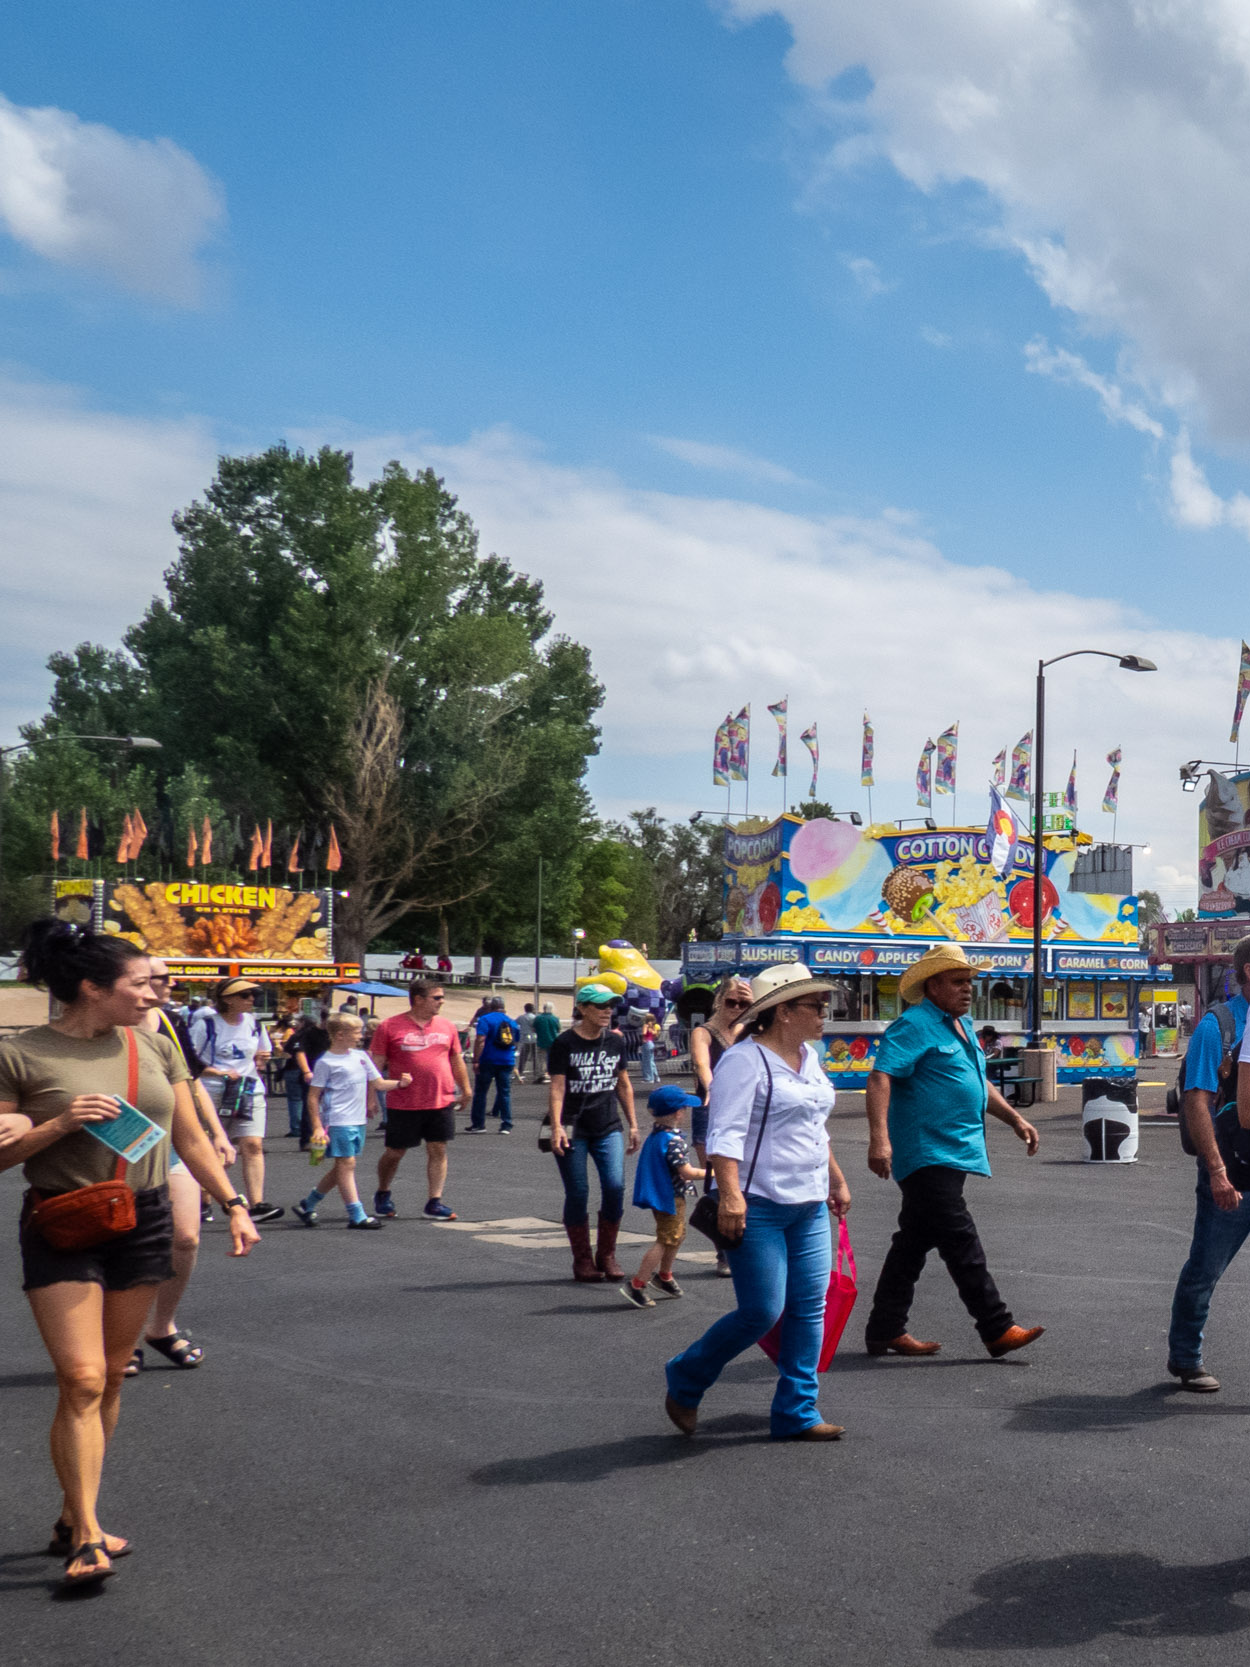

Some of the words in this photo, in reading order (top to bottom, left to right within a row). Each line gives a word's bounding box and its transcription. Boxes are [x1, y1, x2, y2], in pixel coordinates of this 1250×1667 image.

[897, 835, 976, 860] COTTON
[165, 882, 277, 910] CHICKEN
[741, 949, 799, 962] SLUSHIES
[814, 950, 860, 963] CANDY
[876, 952, 921, 965] APPLES
[184, 966, 219, 975] ONION
[1058, 956, 1106, 969] CARAMEL
[1119, 958, 1149, 971] CORN
[241, 967, 337, 977] CHICKEN-ON-A-STICK
[569, 1051, 595, 1067] Wild
